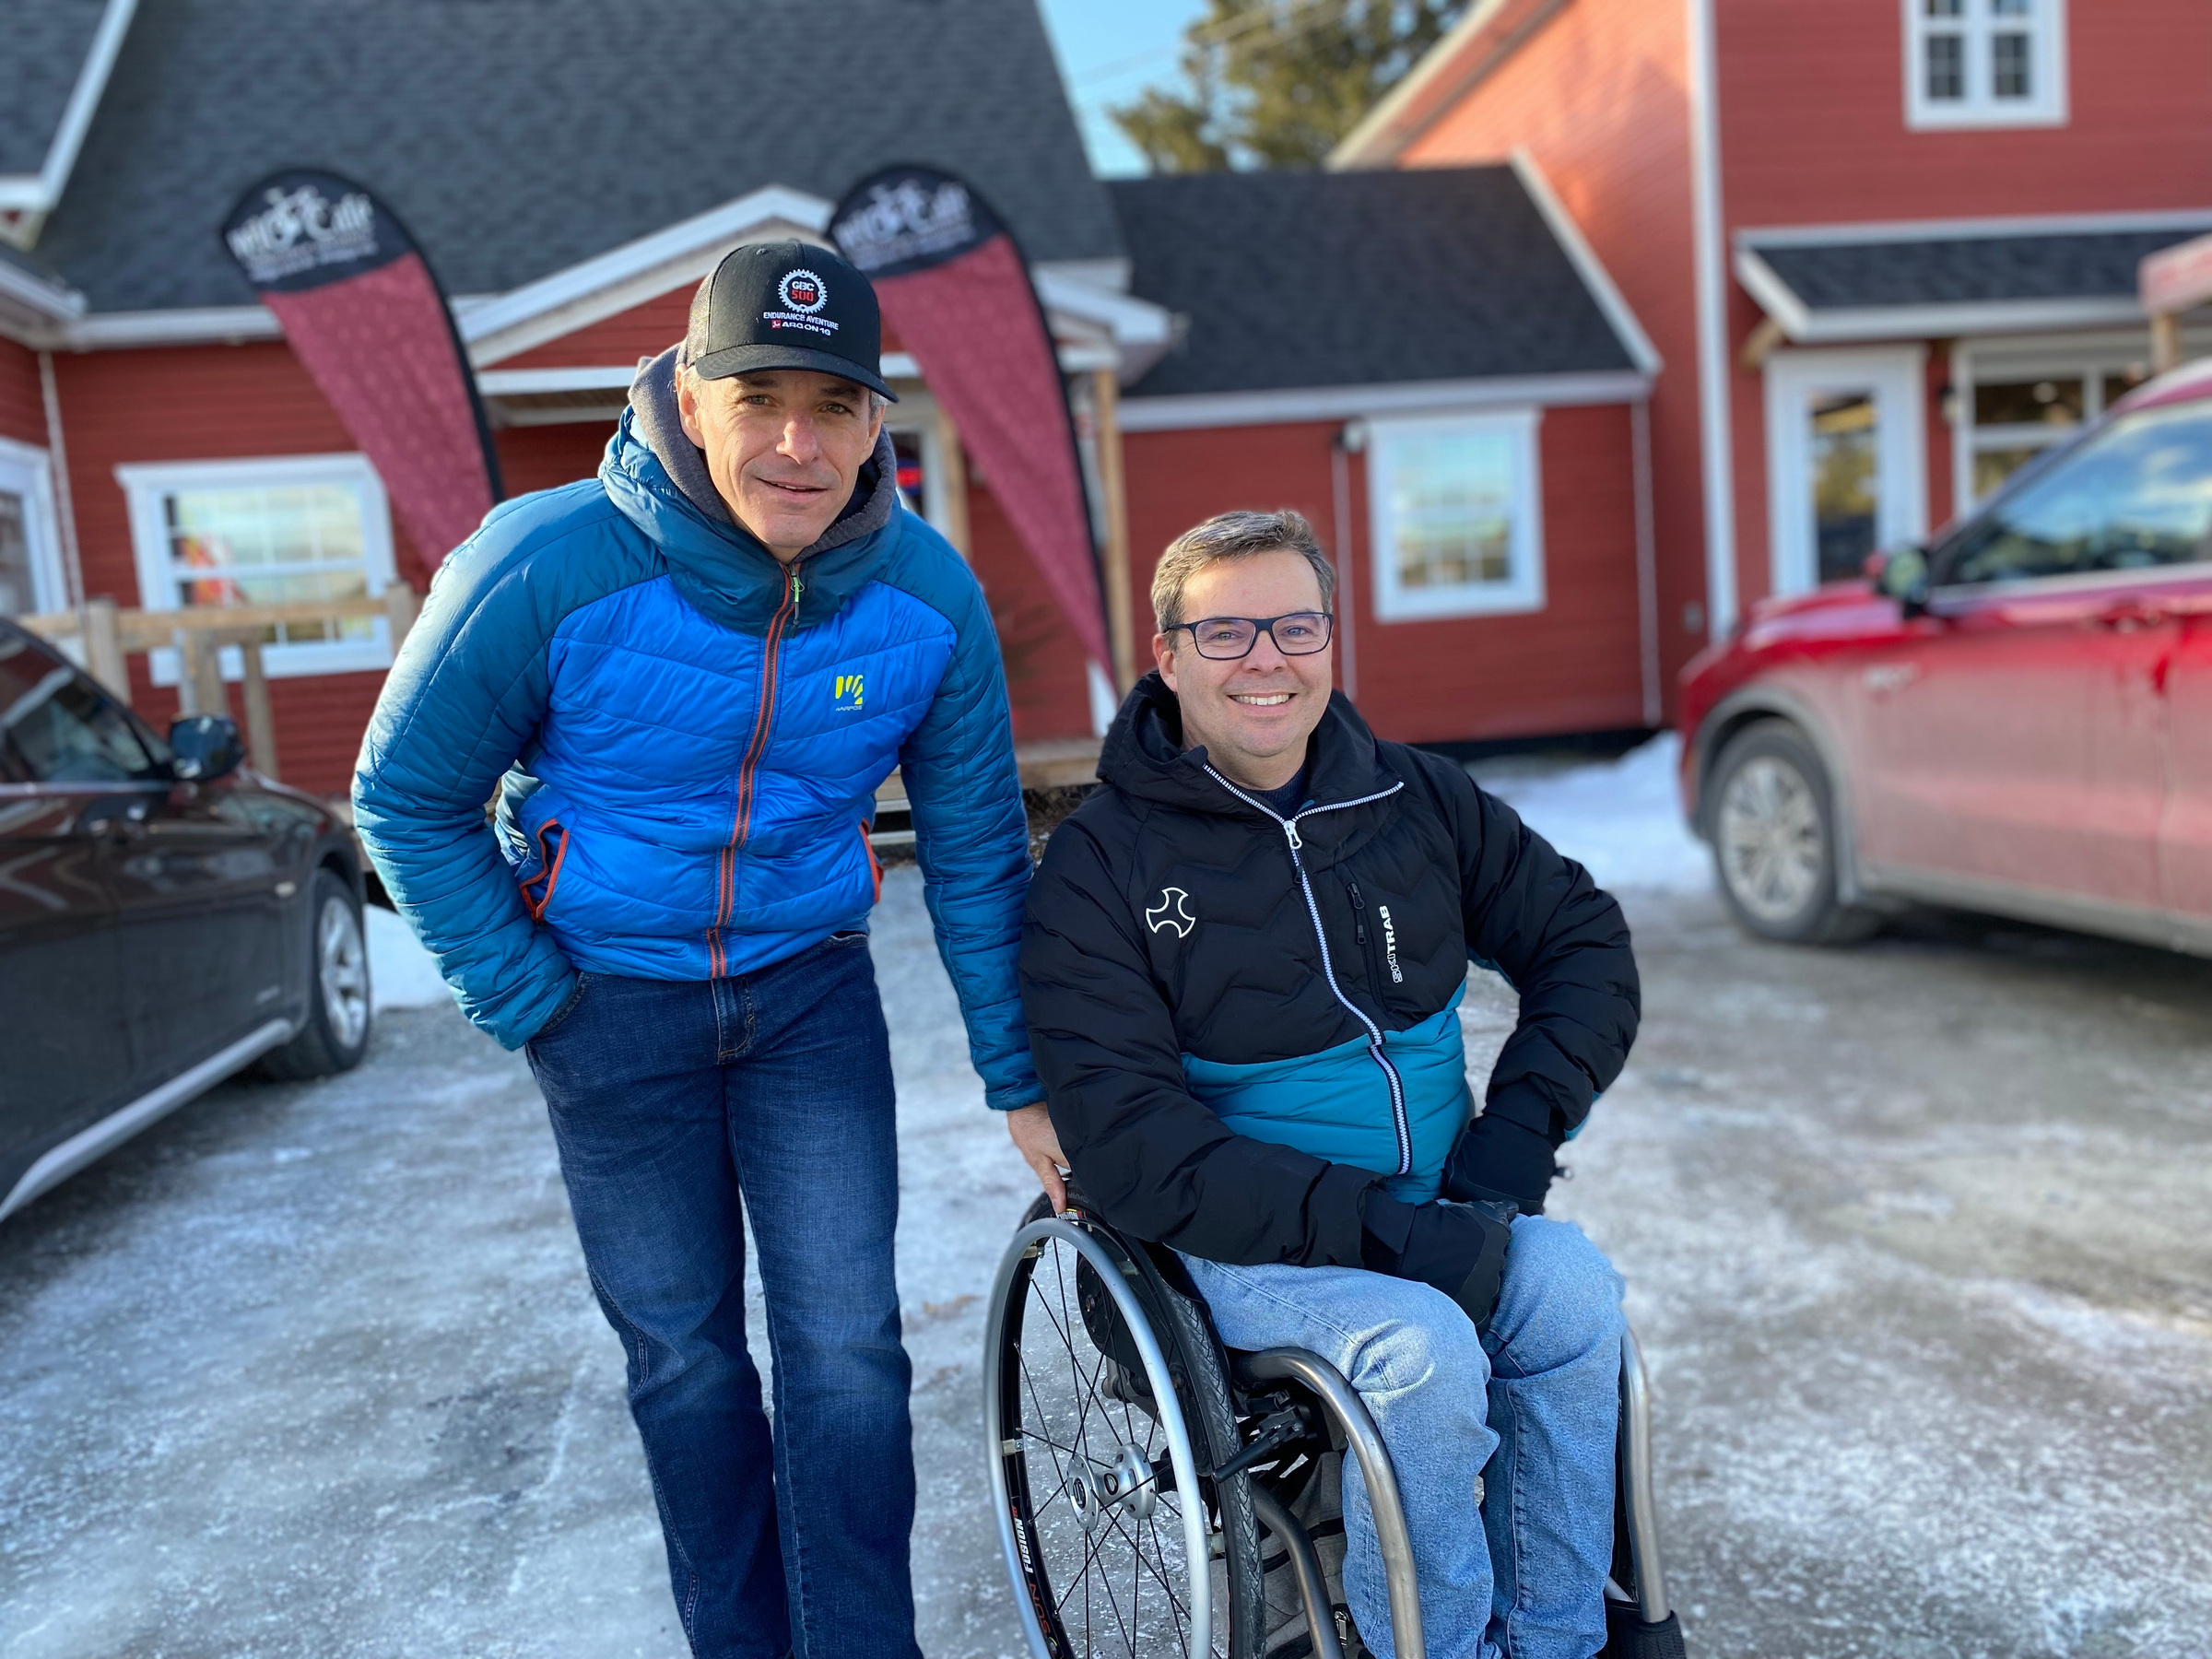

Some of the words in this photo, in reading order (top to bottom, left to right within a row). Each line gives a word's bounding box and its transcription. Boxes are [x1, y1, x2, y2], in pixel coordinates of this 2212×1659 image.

[792, 281, 815, 291] GBC
[792, 289, 815, 301] 500
[763, 312, 806, 322] ENDURANCE
[806, 315, 839, 330] AVENTURE
[1014, 1517, 1034, 1574] FUSION
